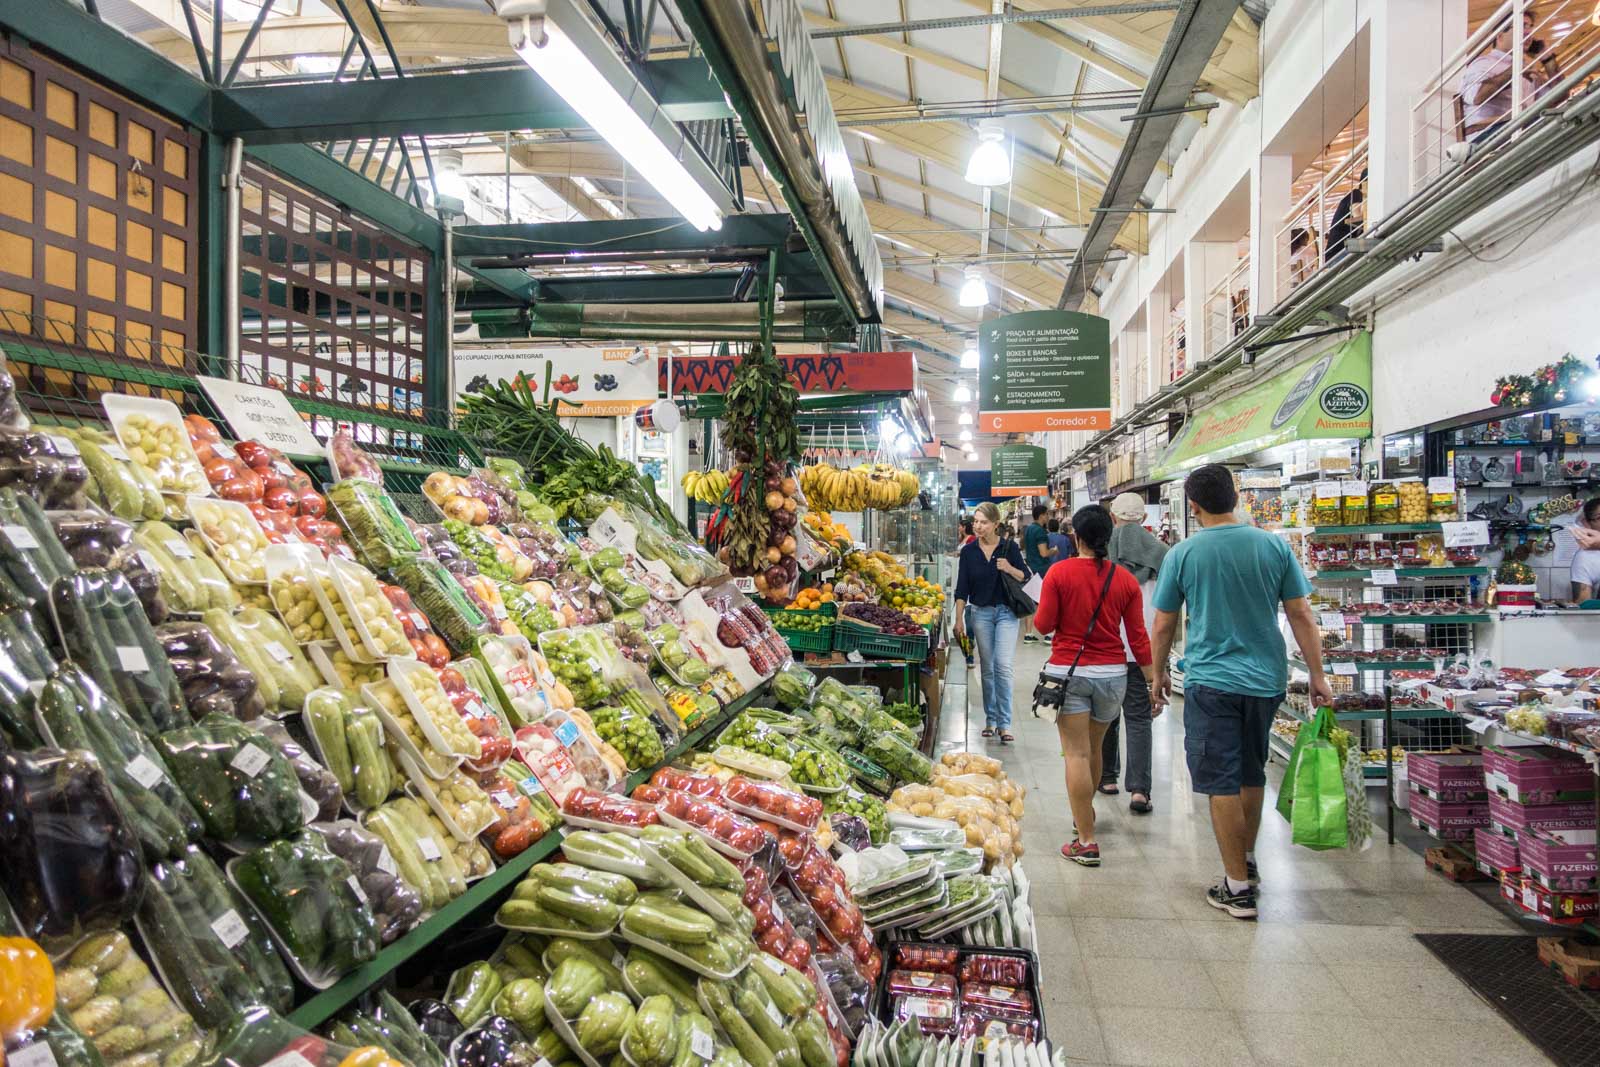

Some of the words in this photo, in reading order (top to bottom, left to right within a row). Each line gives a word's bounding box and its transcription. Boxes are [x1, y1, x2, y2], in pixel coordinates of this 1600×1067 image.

[1006, 330, 1026, 338] PRAÇA
[1036, 328, 1079, 336] ALIMENTAÇÃO
[557, 404, 638, 415] mercafruty.com.b
[993, 417, 1002, 428] C
[1046, 417, 1087, 426] Corredor
[1090, 416, 1097, 425] 3
